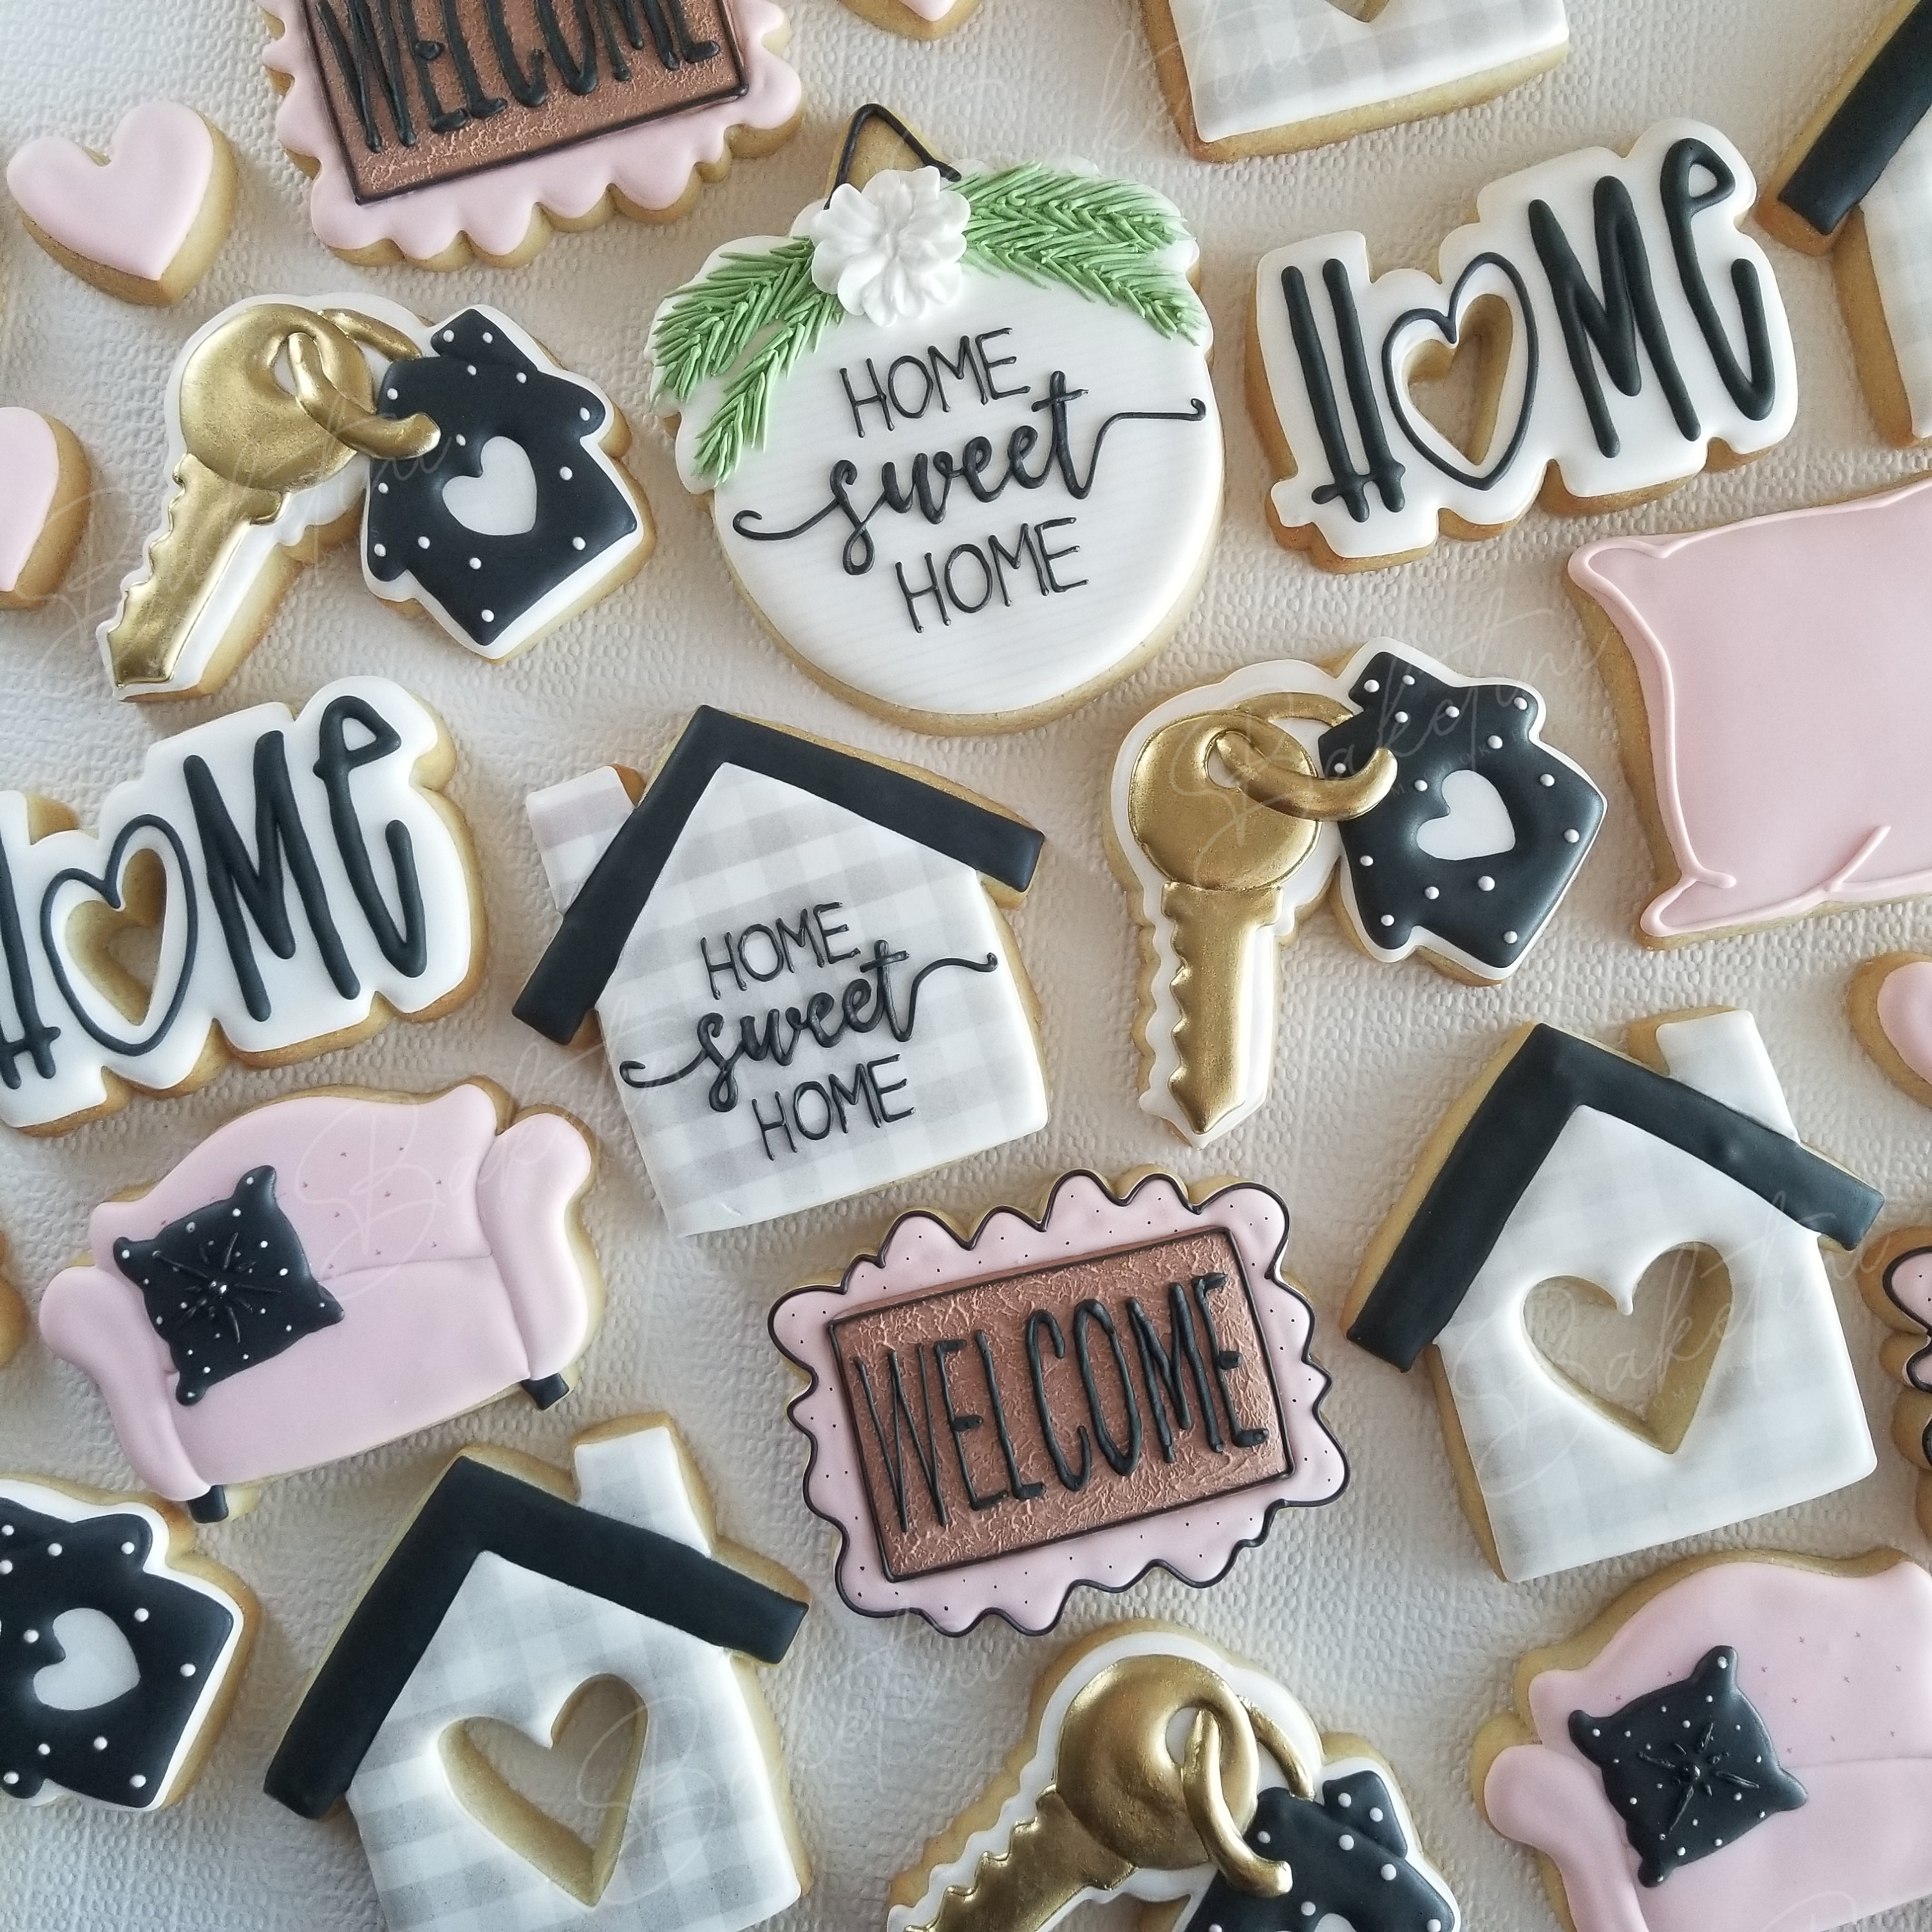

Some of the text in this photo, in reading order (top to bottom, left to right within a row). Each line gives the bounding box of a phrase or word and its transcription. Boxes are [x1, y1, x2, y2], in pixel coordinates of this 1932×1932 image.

[839, 327, 1030, 438] HOME
[732, 370, 1207, 575] sweet
[895, 516, 1089, 633] HOME
[700, 901, 861, 999] HOME
[619, 939, 999, 1112] sweet
[752, 1054, 916, 1161] HOME
[854, 1272, 1269, 1533] WELCOME
